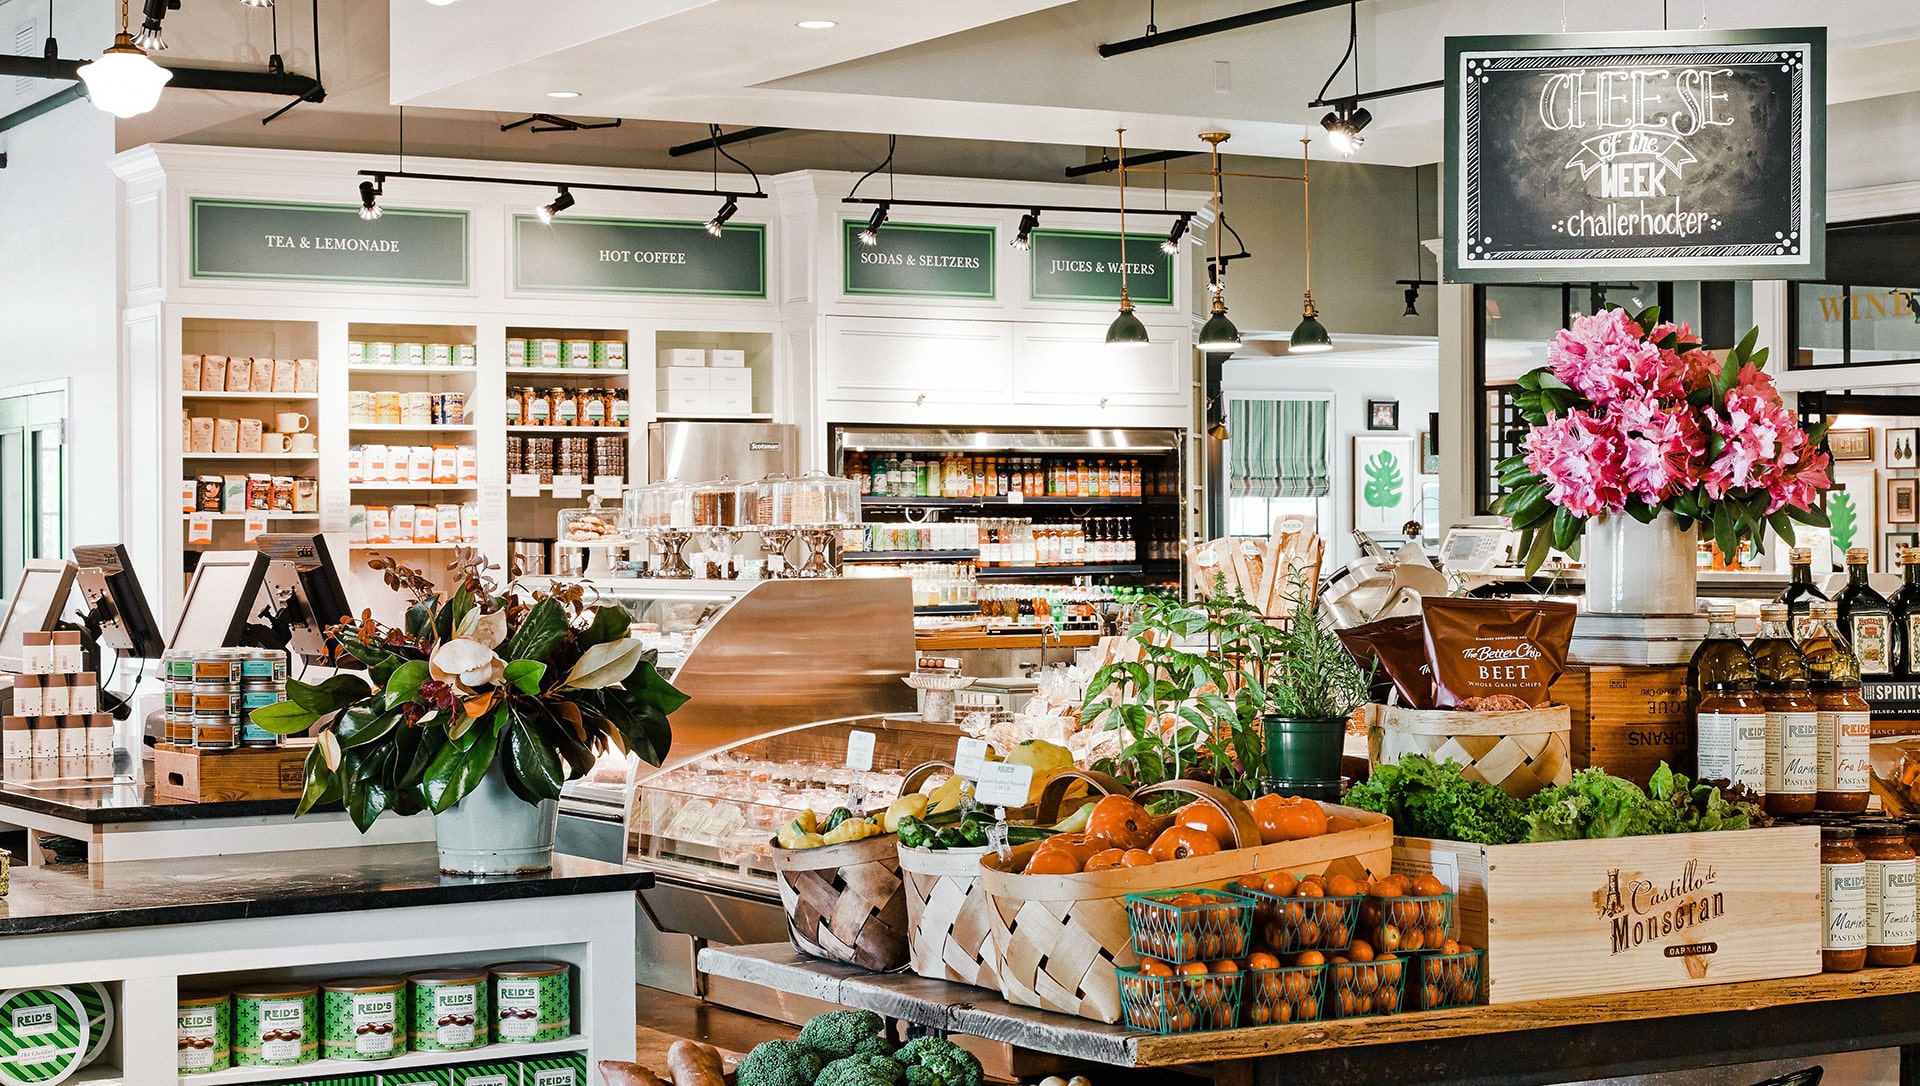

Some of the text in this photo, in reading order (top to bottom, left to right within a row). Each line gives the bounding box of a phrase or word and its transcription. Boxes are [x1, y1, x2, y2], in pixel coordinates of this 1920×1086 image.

[1539, 68, 1735, 136] CHEESE
[1598, 131, 1659, 161] of the
[1601, 162, 1666, 198] WEEK
[1567, 196, 1708, 238] challerhocker
[265, 235, 400, 253] TEA & LEMONADE
[599, 250, 687, 264] HOT COFFEE
[860, 252, 980, 269] SODAS & SELTZERS
[1050, 259, 1155, 275] JUICES & WATERS
[1462, 642, 1542, 661] The Better Chip
[1478, 665, 1530, 680] BEET
[1468, 680, 1492, 688] WHOLE
[1837, 758, 1854, 772] Fra
[1784, 778, 1808, 786] PASTA
[1628, 858, 1717, 916] Castillo de
[1610, 891, 1725, 957] Monséran
[1830, 933, 1856, 942] PASTA
[1884, 930, 1908, 938] PASTA
[439, 993, 473, 1007] REID'S
[501, 988, 536, 1000] REID'S
[264, 1008, 300, 1021] REID'S
[358, 1001, 392, 1015] REID'S
[17, 1012, 53, 1028] REID'S
[177, 1016, 213, 1029] REID'S
[539, 1075, 572, 1086] REID'S
